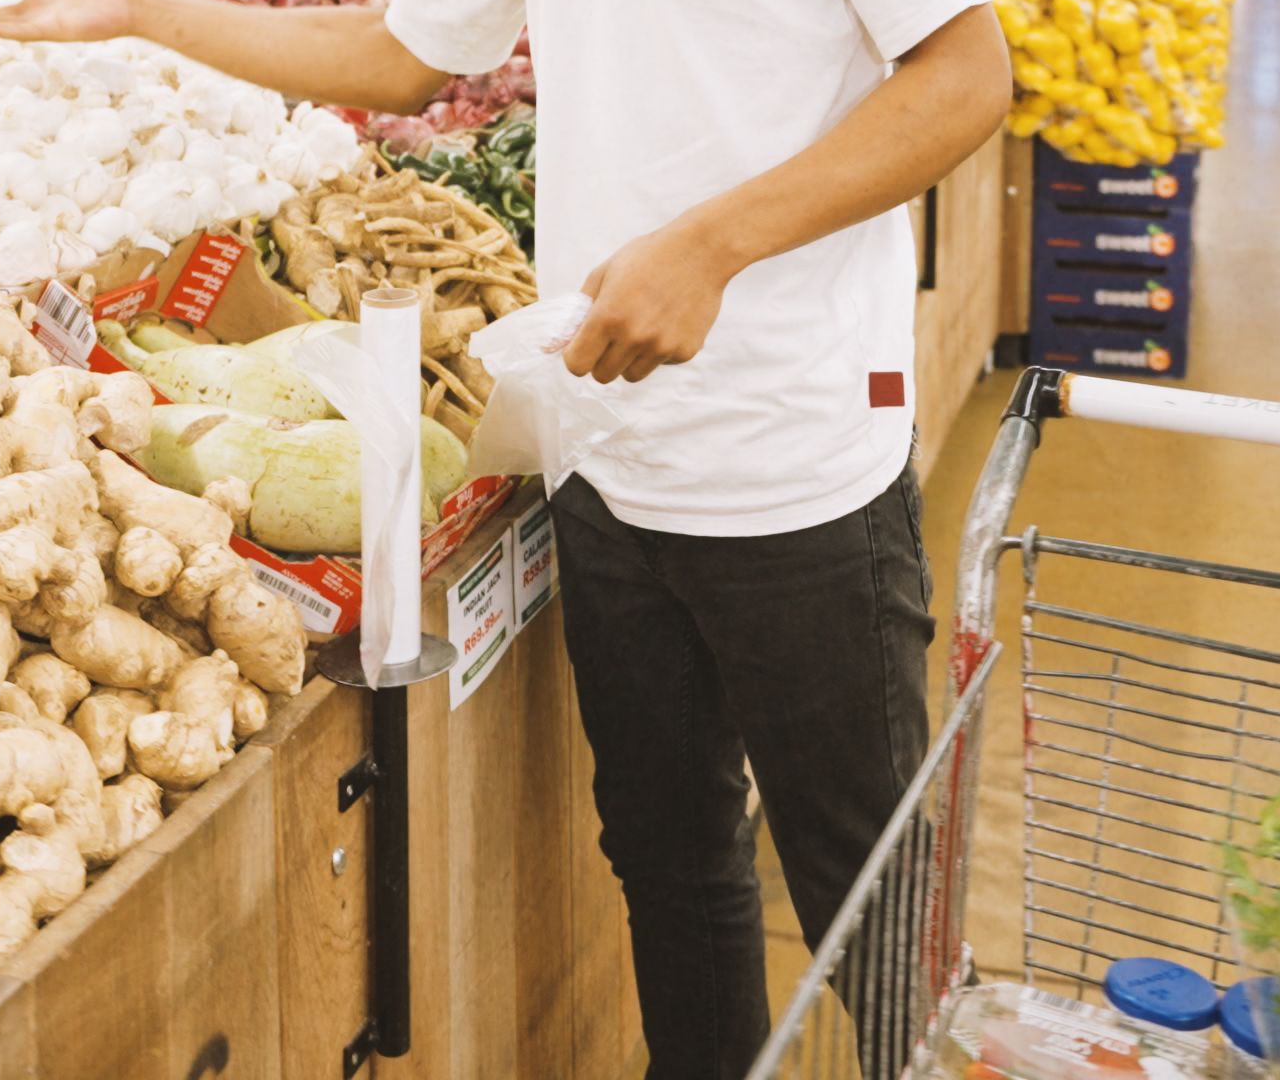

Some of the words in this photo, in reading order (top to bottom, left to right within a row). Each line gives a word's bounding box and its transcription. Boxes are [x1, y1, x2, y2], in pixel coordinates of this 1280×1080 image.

[463, 589, 486, 618] INDIAN
[486, 571, 503, 597] JACK
[475, 595, 494, 621] FRUIT
